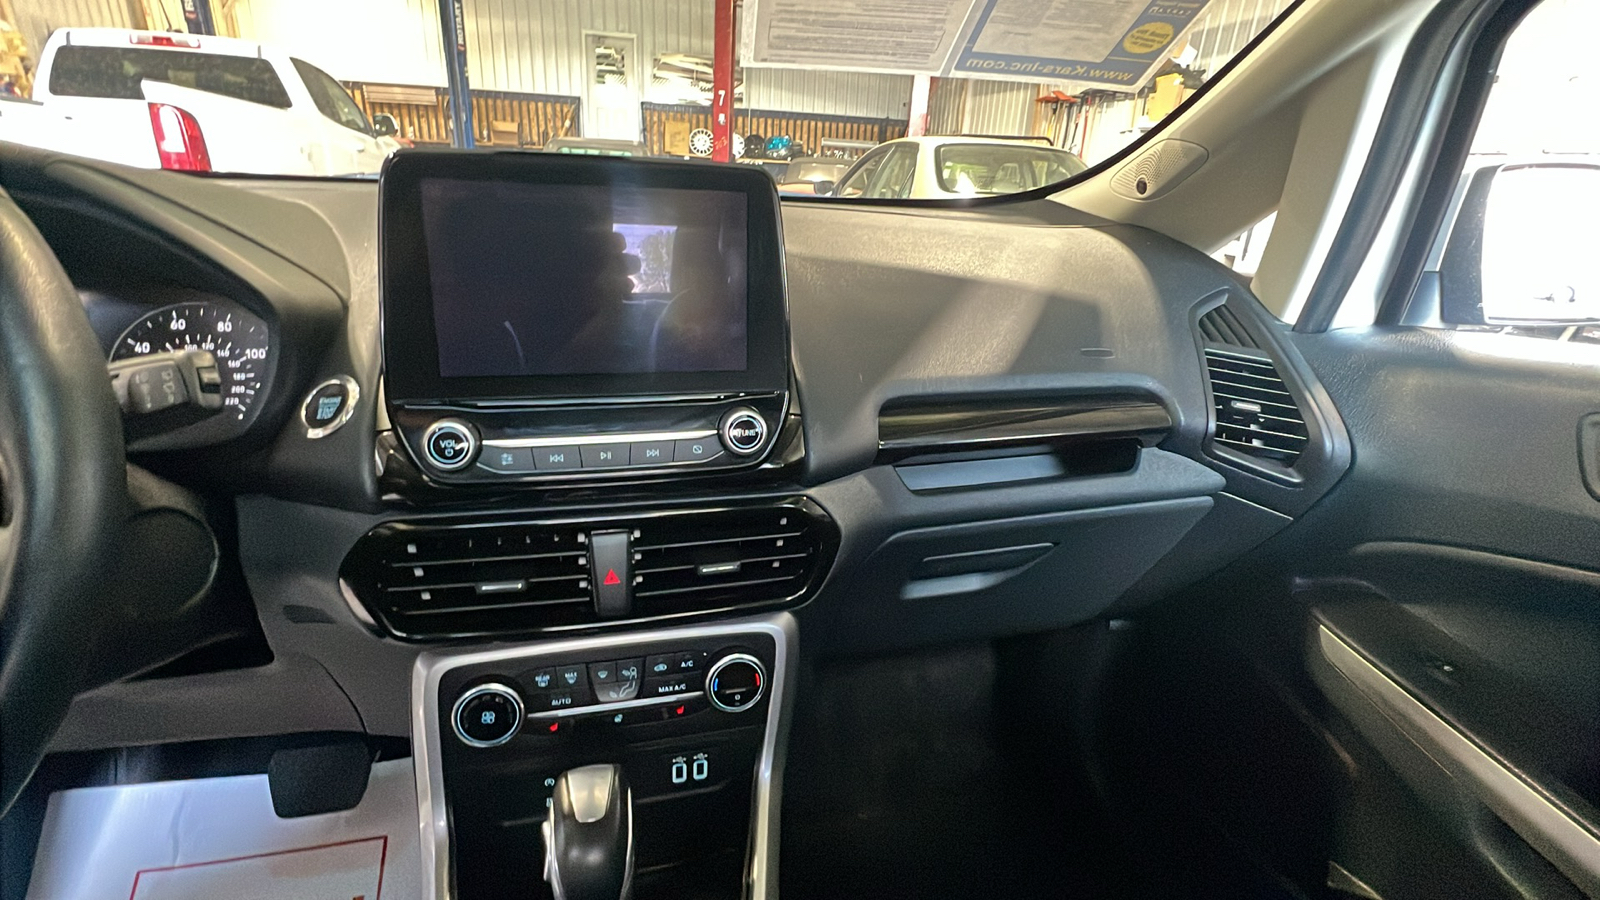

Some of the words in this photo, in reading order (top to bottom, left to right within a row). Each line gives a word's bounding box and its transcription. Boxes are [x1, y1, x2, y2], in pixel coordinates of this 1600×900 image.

[718, 90, 725, 106] 7
[170, 319, 186, 330] 60
[217, 321, 232, 332] 80
[134, 341, 150, 353] 40
[217, 349, 230, 357] 140
[245, 348, 266, 359] 100
[440, 439, 458, 448] VOL
[551, 697, 572, 706] AUTO
